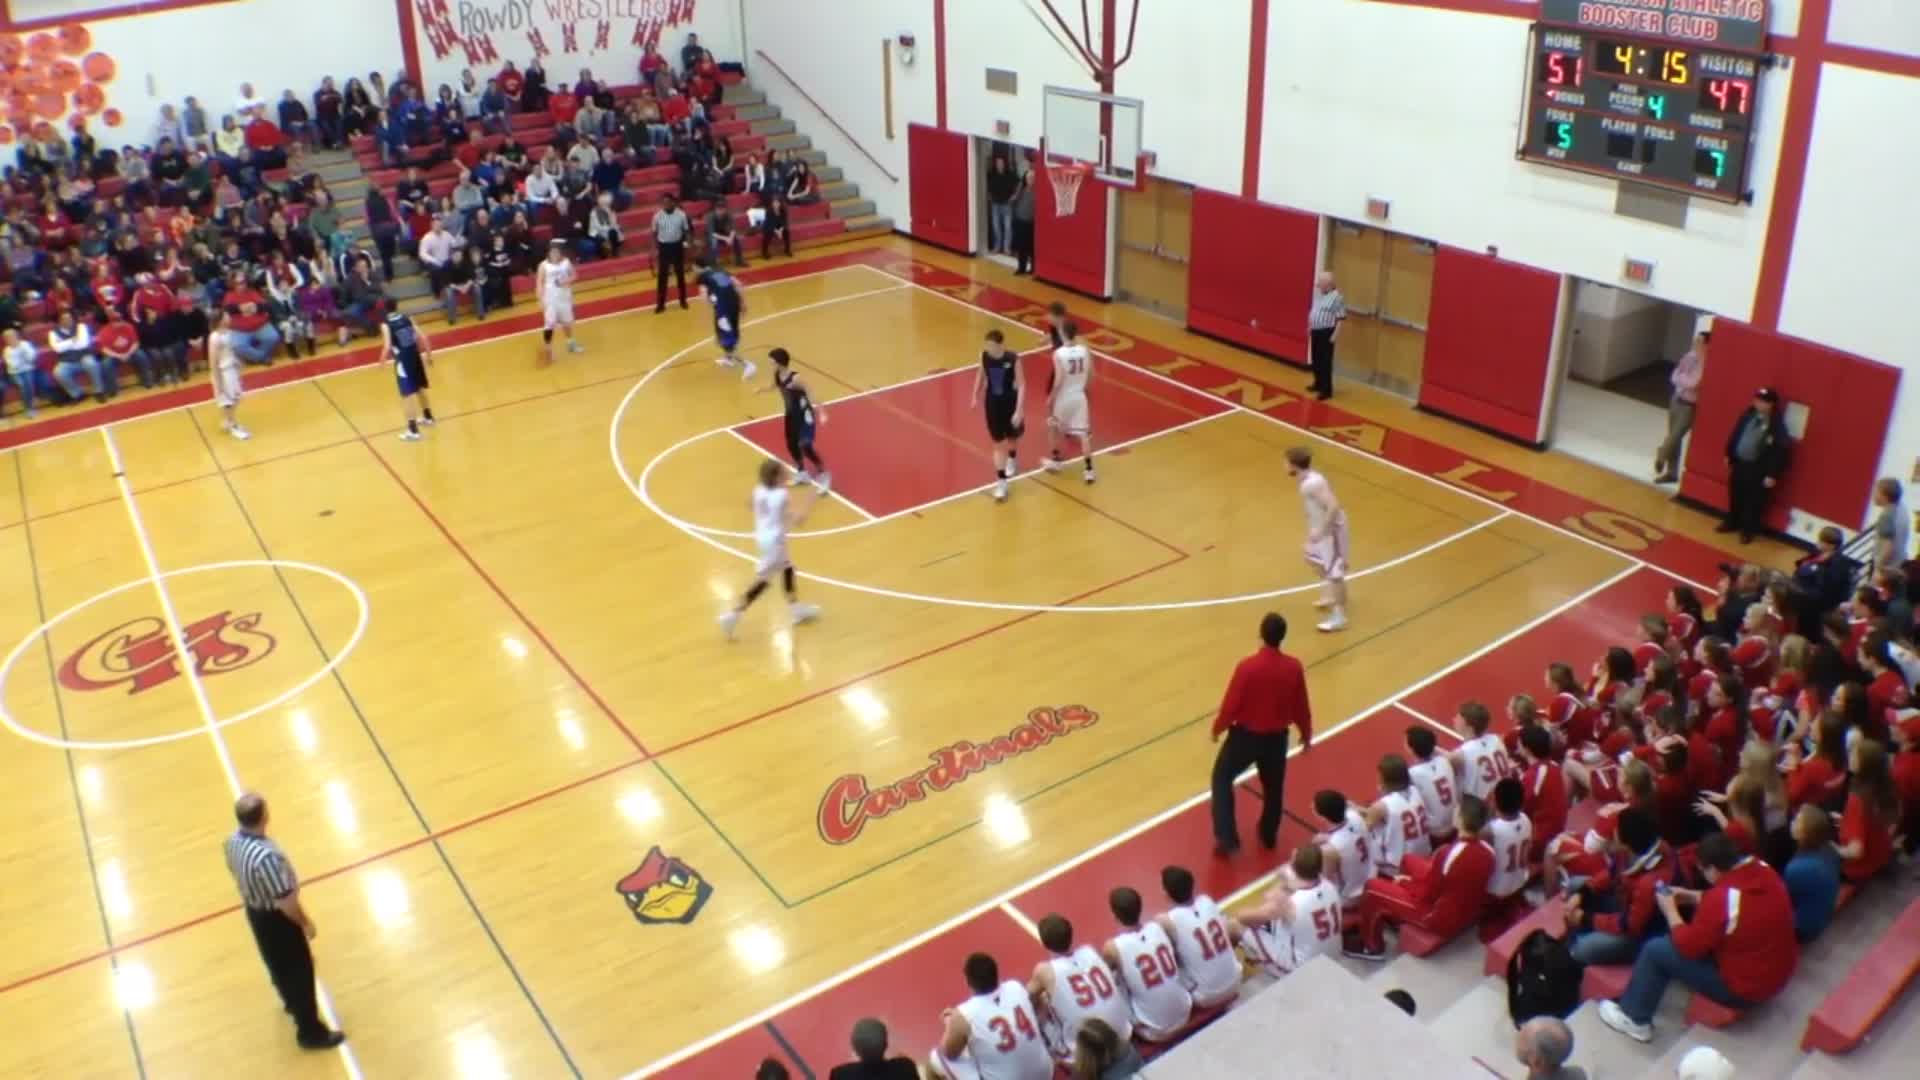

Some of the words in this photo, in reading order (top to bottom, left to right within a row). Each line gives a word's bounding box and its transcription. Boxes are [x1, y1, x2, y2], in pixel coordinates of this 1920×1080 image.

[460, 0, 535, 35] ROWDY
[1579, 4, 1663, 33] BOOSTER
[1666, 14, 1718, 41] CLUB
[1545, 32, 1582, 50] HOME
[1549, 53, 1583, 87] 51
[1615, 45, 1687, 84] 4:15
[1699, 54, 1755, 76] VISITOR
[1647, 95, 1664, 120] 4
[1710, 80, 1749, 114] 47
[1557, 123, 1572, 149] 5
[1710, 151, 1726, 177] 7
[816, 703, 1099, 846] Cardinals
[1476, 751, 1510, 785] 30
[1432, 775, 1453, 806] 5
[1191, 923, 1231, 961] 12
[1135, 948, 1178, 990] 20
[1068, 966, 1115, 1008] 50
[987, 1004, 1037, 1054] 34
